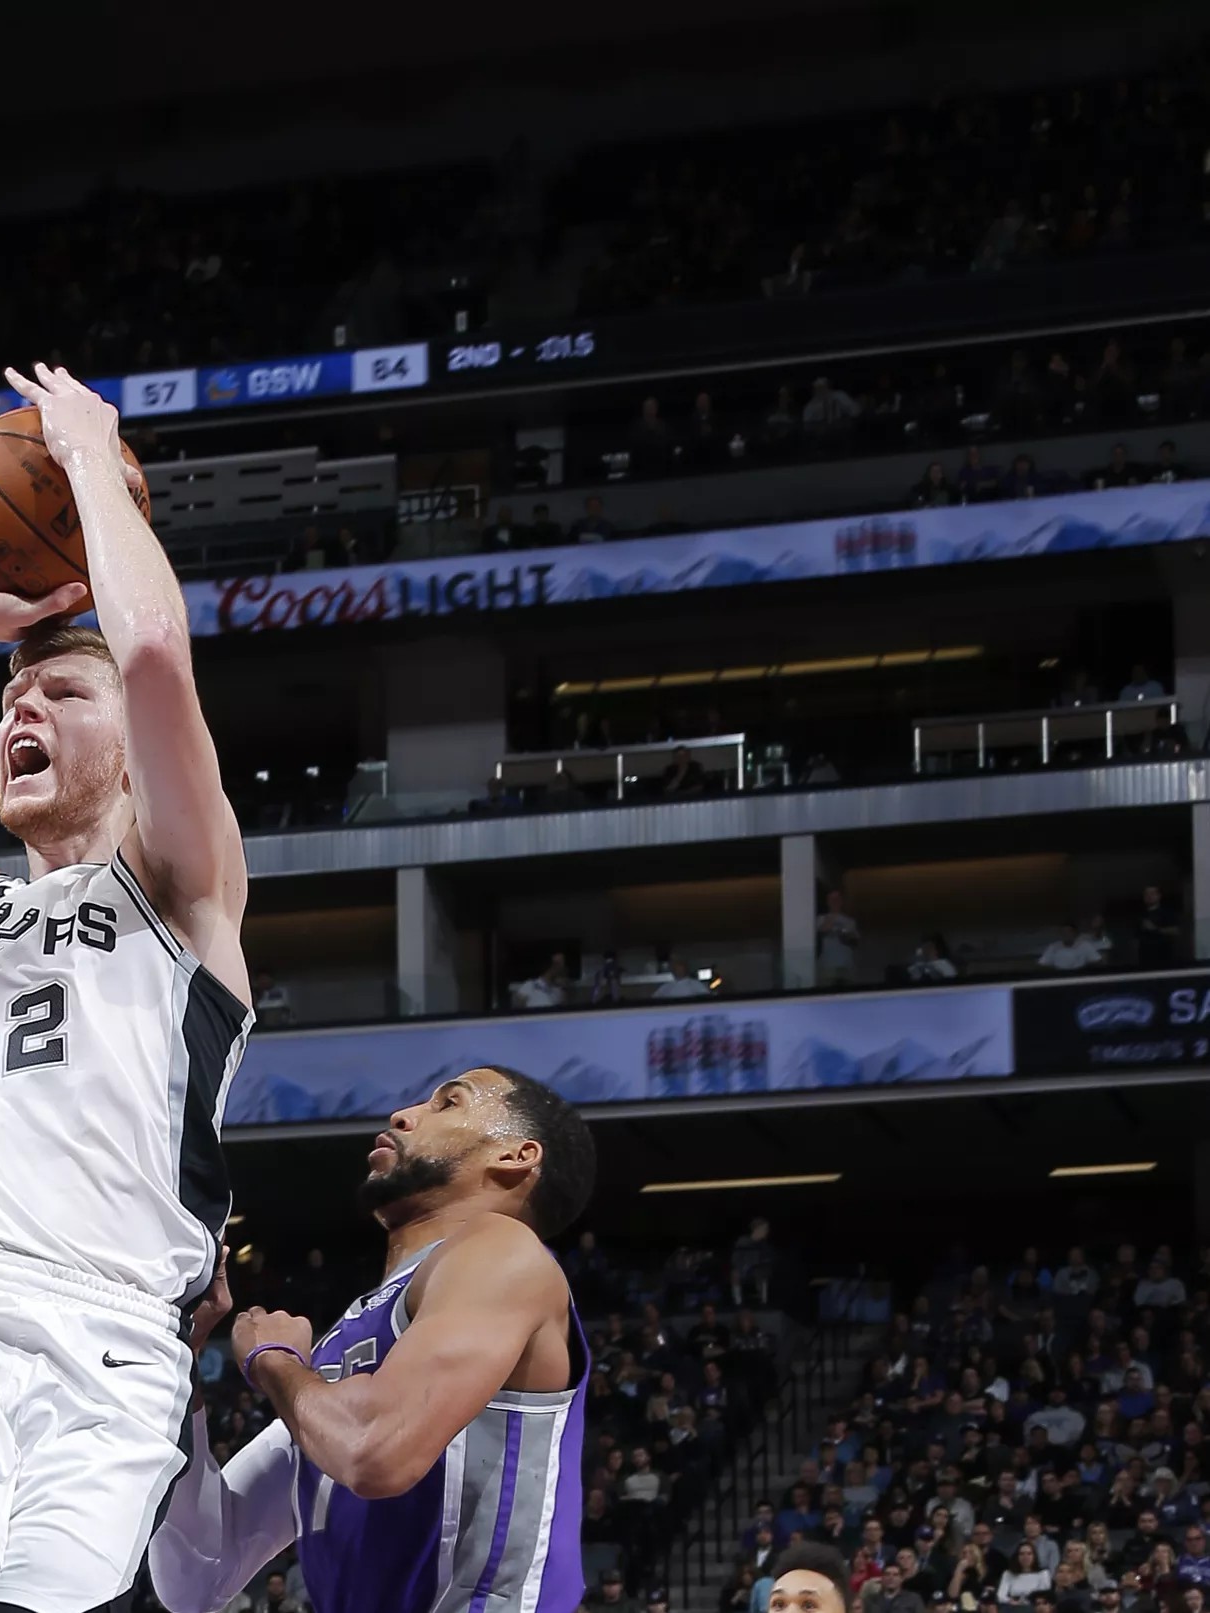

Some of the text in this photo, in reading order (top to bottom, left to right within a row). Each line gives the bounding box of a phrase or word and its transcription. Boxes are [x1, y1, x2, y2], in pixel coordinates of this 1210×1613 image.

[247, 361, 322, 397] GSW
[212, 563, 555, 633] Coors LIGHT
